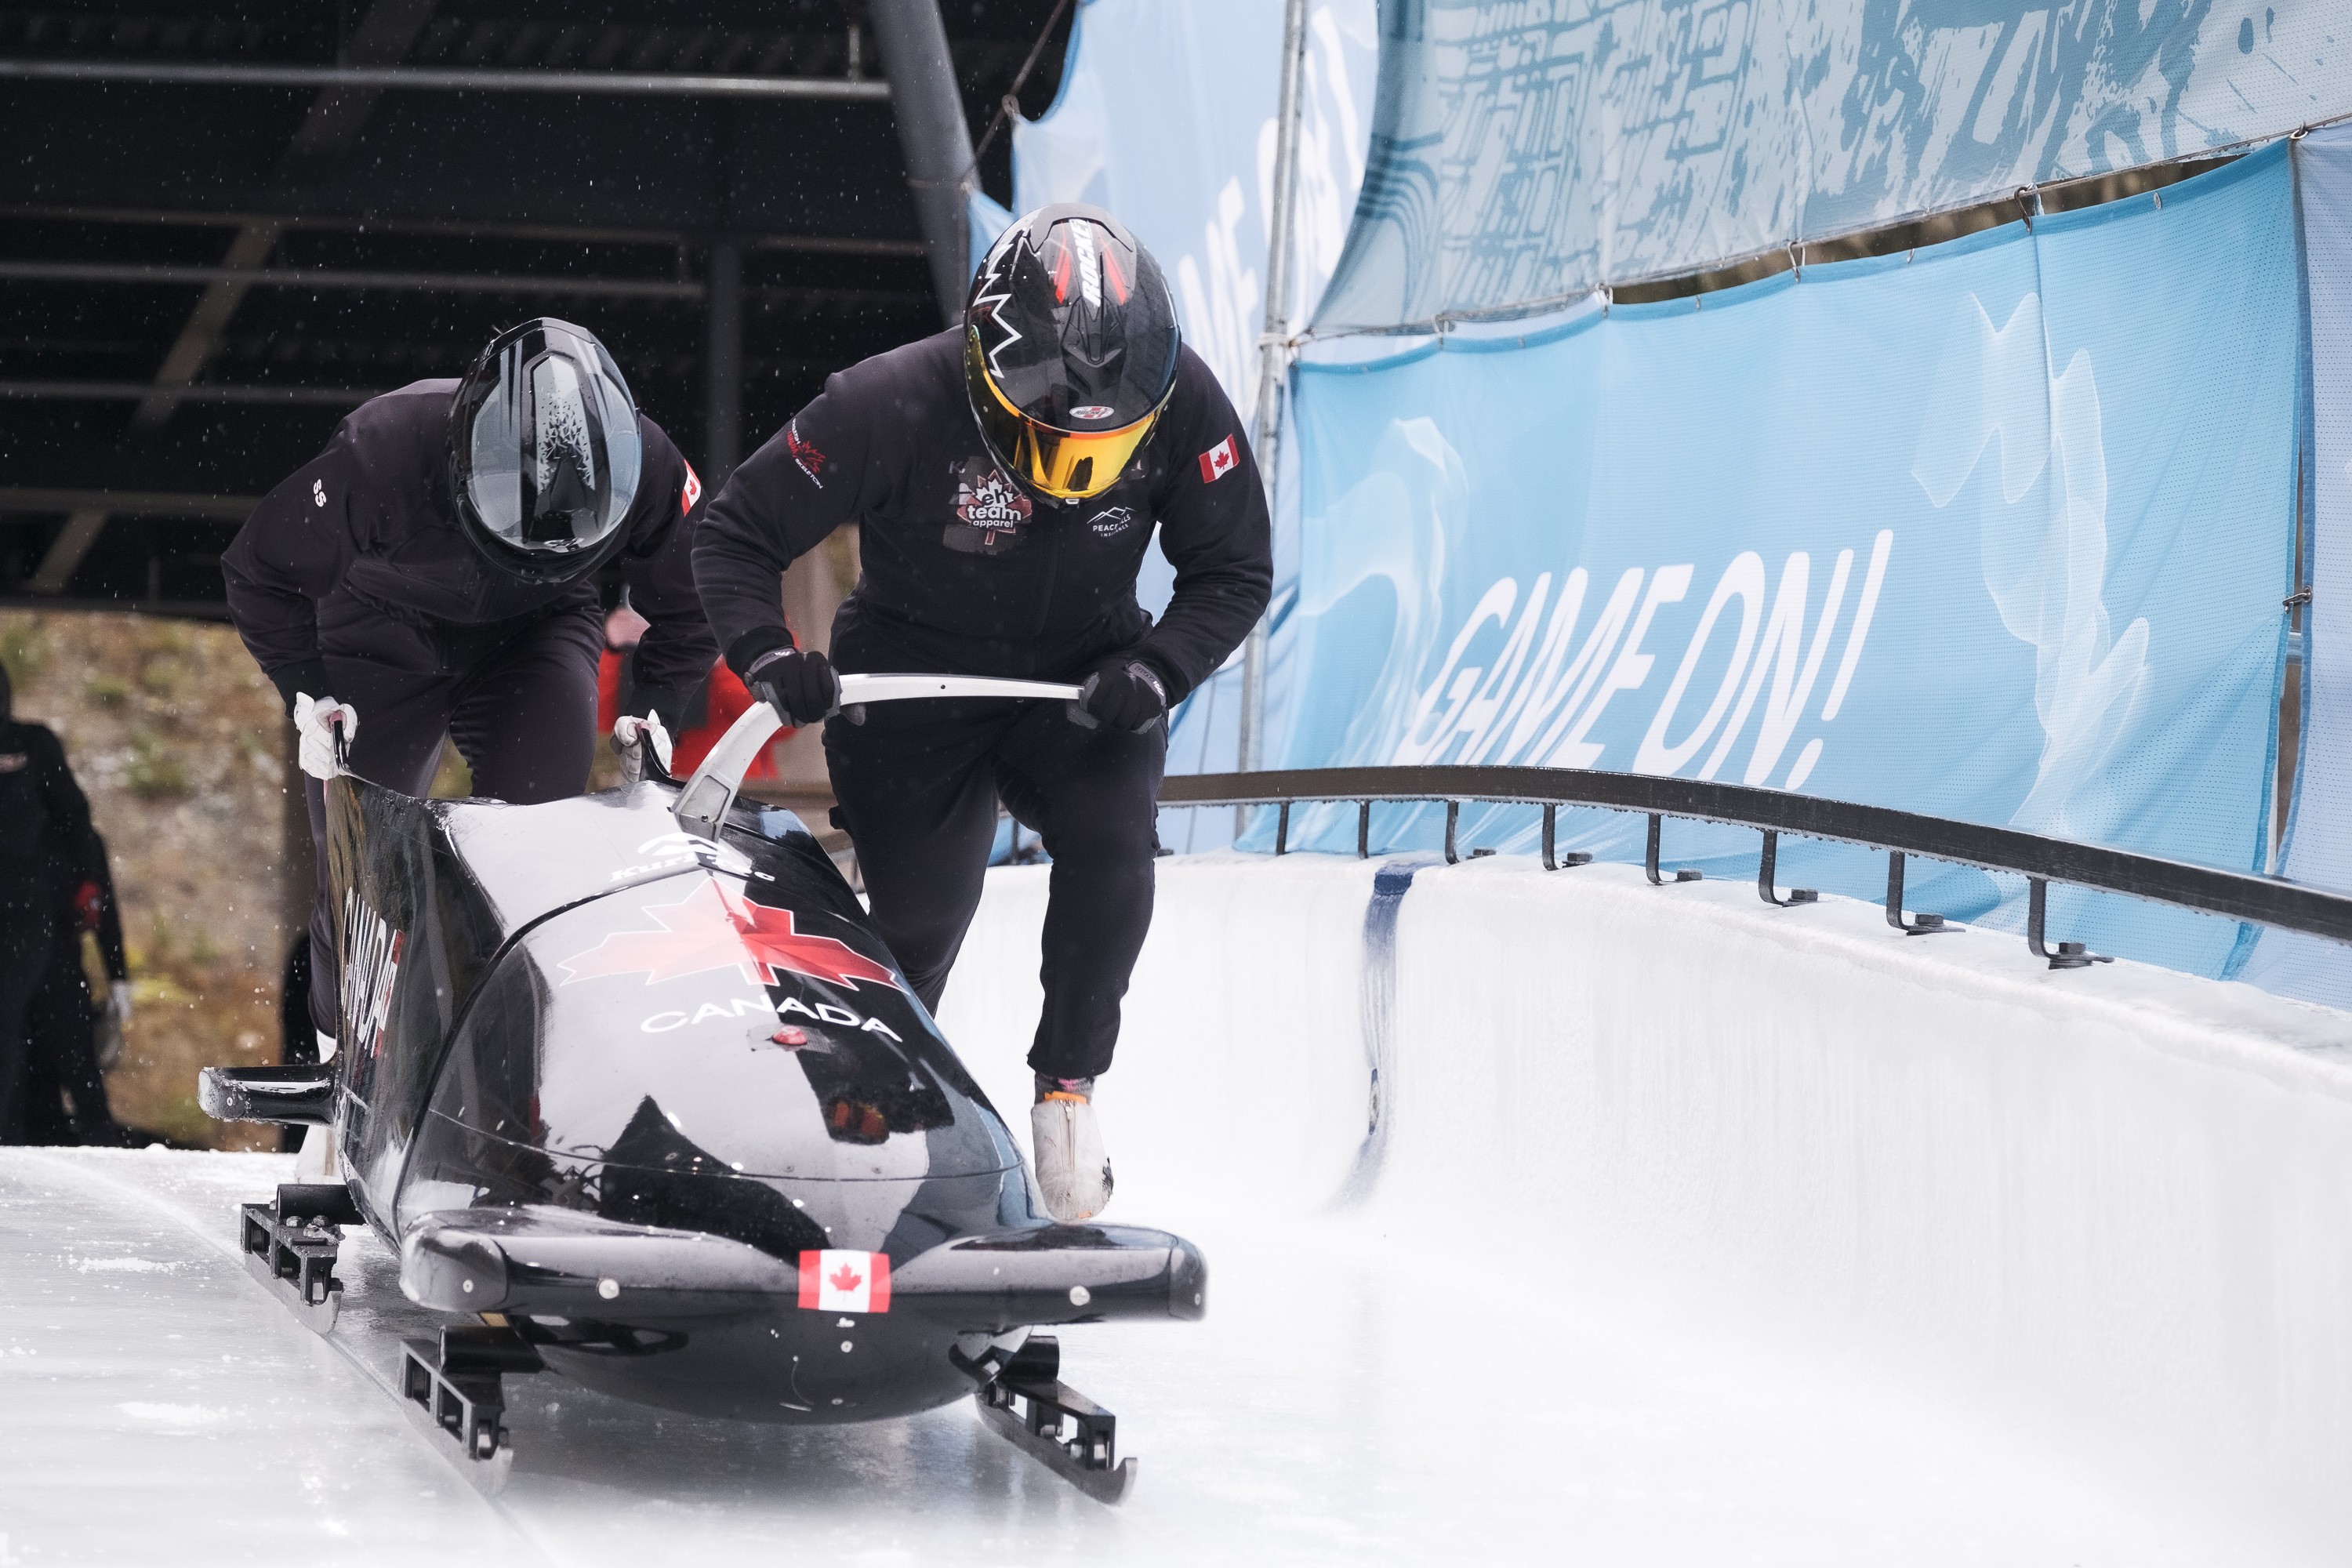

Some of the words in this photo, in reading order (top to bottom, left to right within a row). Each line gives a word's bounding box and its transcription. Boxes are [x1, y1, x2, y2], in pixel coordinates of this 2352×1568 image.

[794, 458, 823, 489] SKELETON
[967, 505, 1022, 521] team
[982, 488, 1007, 507] eh
[972, 519, 1014, 529] apparel
[1392, 562, 1695, 772] GAME
[1632, 528, 1894, 791] ON!
[341, 886, 398, 1059] CANADA
[641, 994, 903, 1043] CANADA
